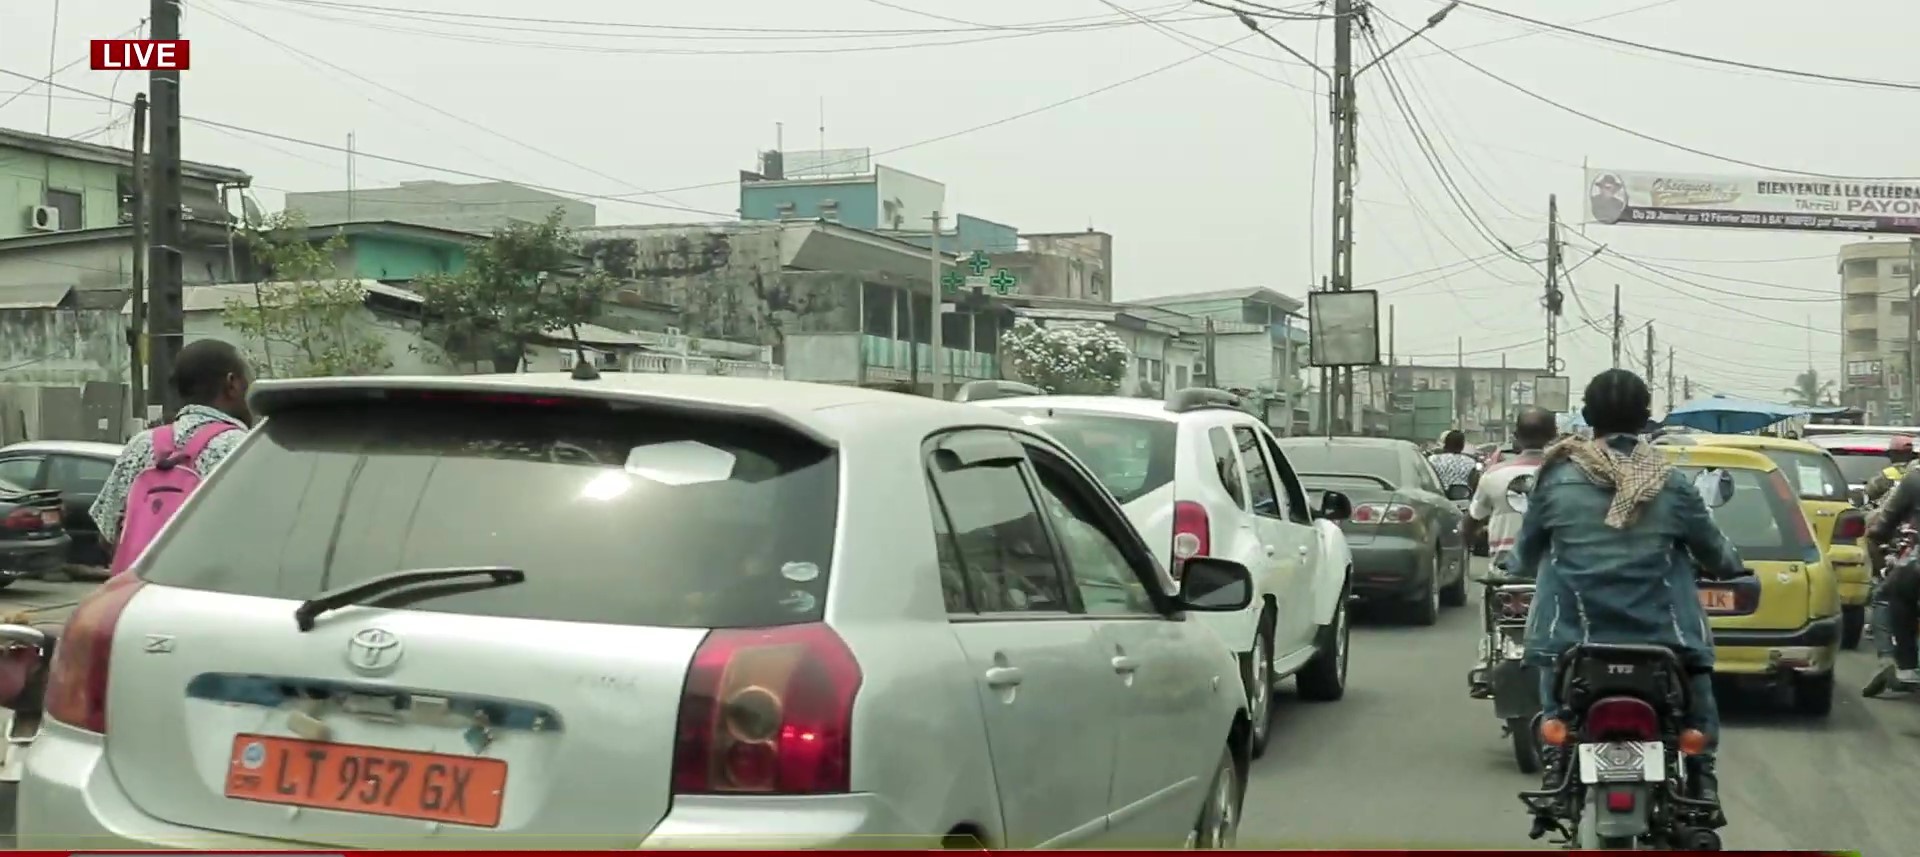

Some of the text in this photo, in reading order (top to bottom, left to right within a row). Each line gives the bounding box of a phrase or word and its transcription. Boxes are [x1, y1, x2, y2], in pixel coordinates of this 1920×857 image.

[1757, 181, 1831, 196] BIENVENUE
[1844, 184, 1860, 197] LA
[1632, 208, 1645, 219] Du
[1700, 212, 1710, 222] 12
[276, 748, 473, 816] LT 957 GX
